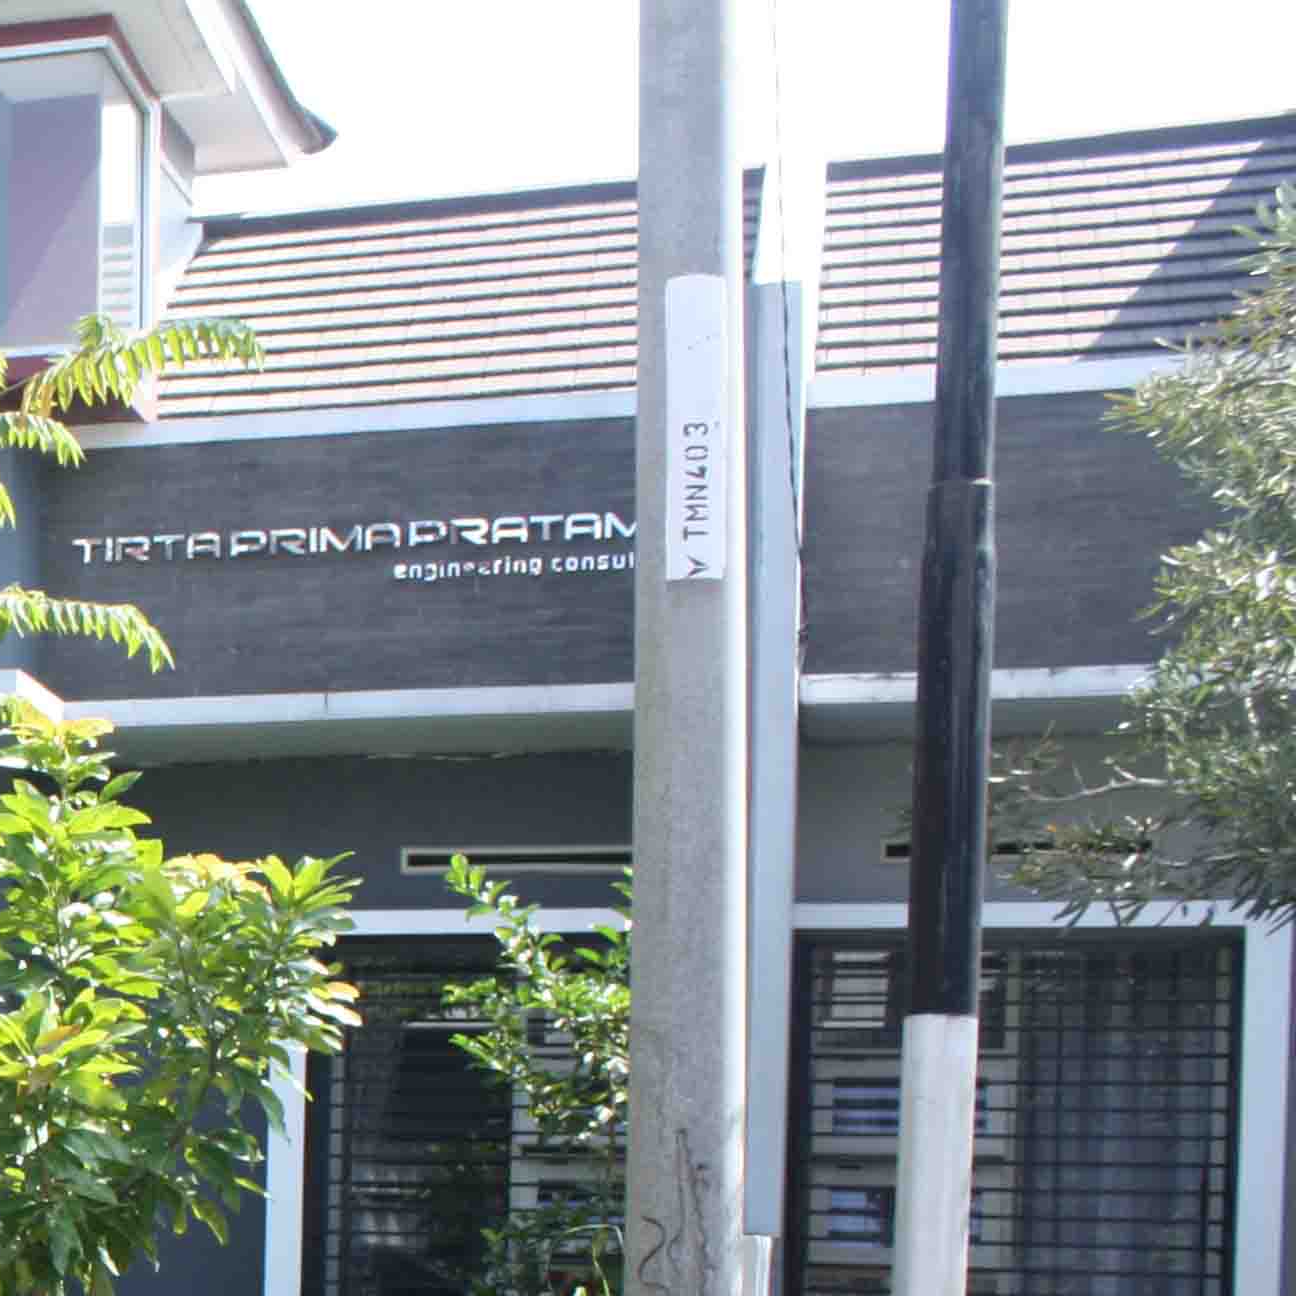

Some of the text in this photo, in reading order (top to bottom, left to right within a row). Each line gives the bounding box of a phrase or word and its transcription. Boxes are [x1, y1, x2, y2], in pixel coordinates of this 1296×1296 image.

[72, 532, 221, 564] TIRTA
[229, 523, 401, 558] PRIMA
[393, 555, 543, 582] engineering
